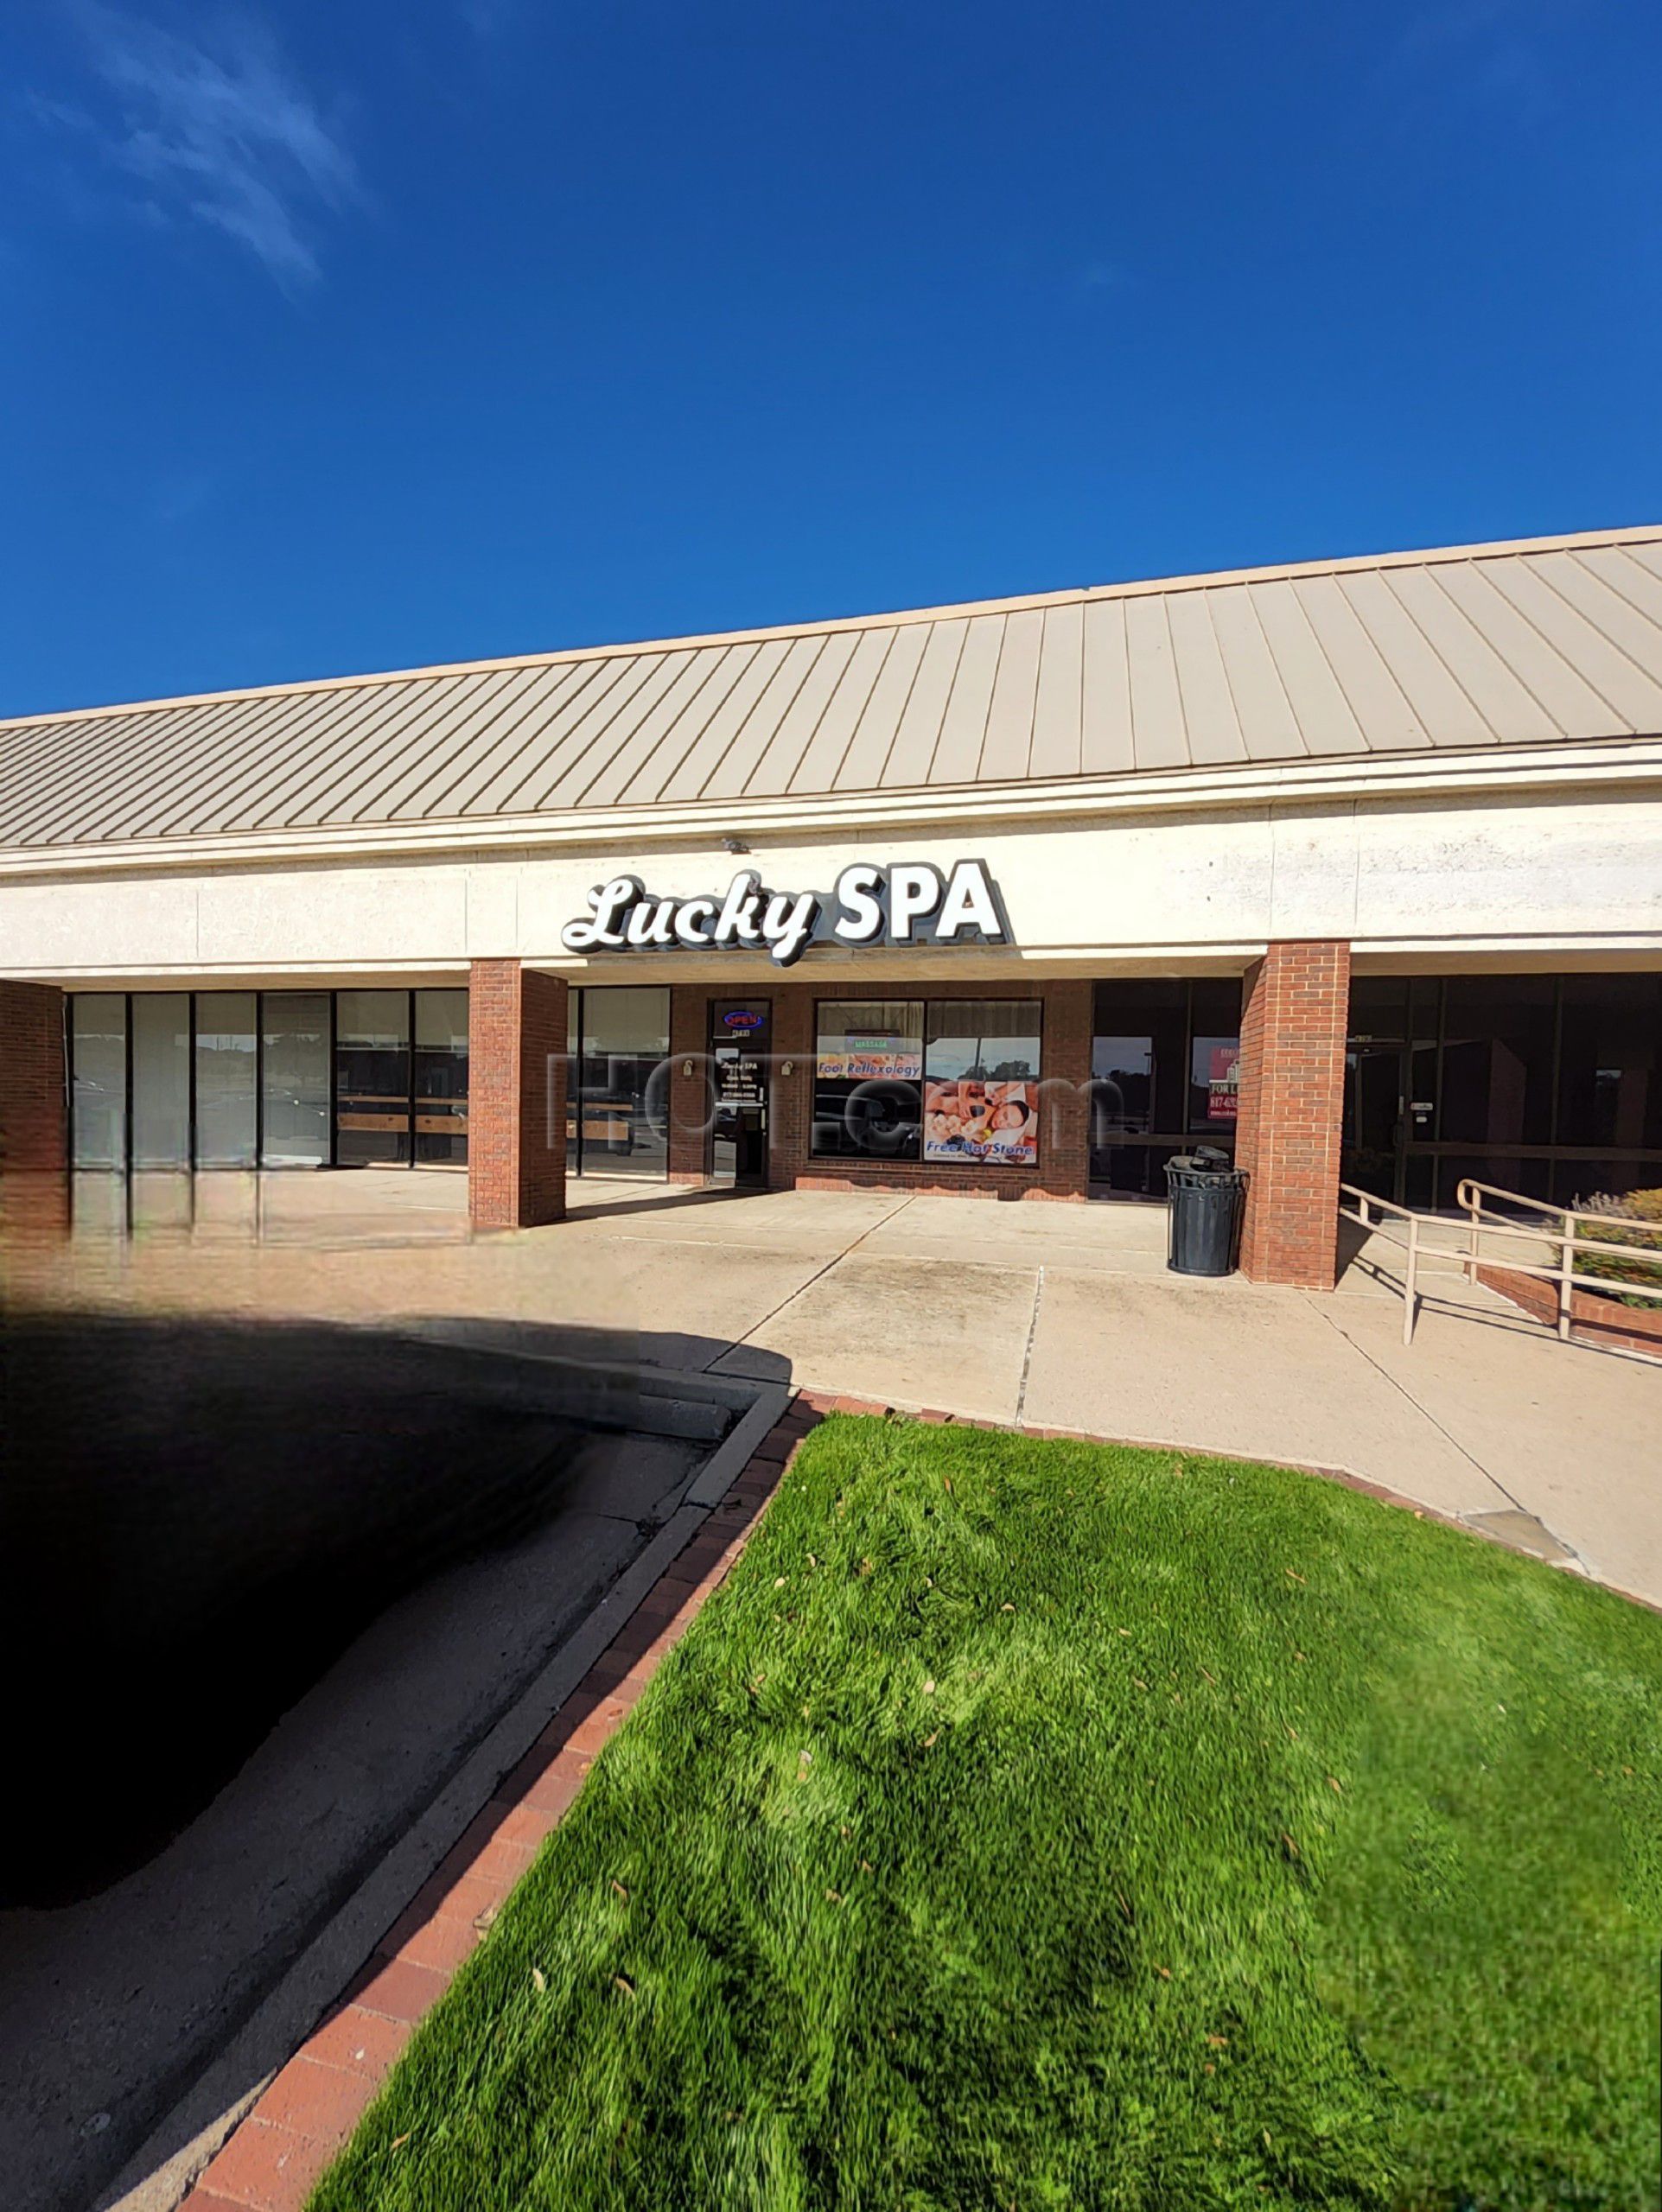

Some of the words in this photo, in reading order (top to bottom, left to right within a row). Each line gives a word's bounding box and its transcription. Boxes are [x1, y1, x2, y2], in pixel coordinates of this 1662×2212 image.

[561, 869, 818, 967] Lucky
[833, 859, 1014, 946] SPA
[848, 1062, 920, 1077] Reflexology
[1212, 1084, 1229, 1095] FOR
[927, 1141, 958, 1153] Free
[963, 1141, 990, 1154] Hot
[993, 1143, 1033, 1155] Stone
